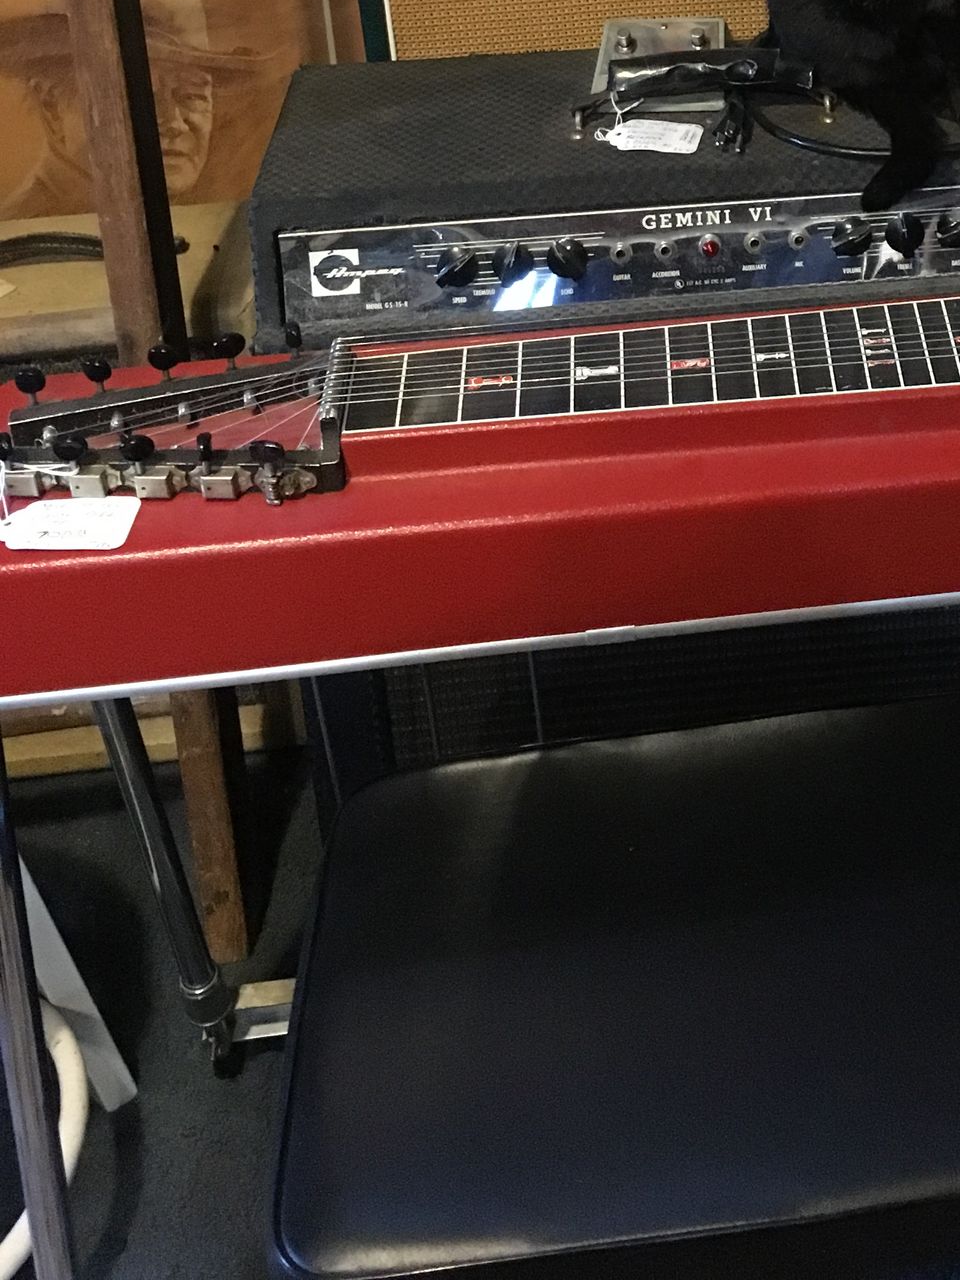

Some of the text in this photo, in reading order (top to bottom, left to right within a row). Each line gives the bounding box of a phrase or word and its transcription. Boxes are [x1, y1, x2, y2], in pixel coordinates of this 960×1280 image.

[642, 207, 772, 230] GEMINI VI
[323, 265, 406, 279] Ampeg
